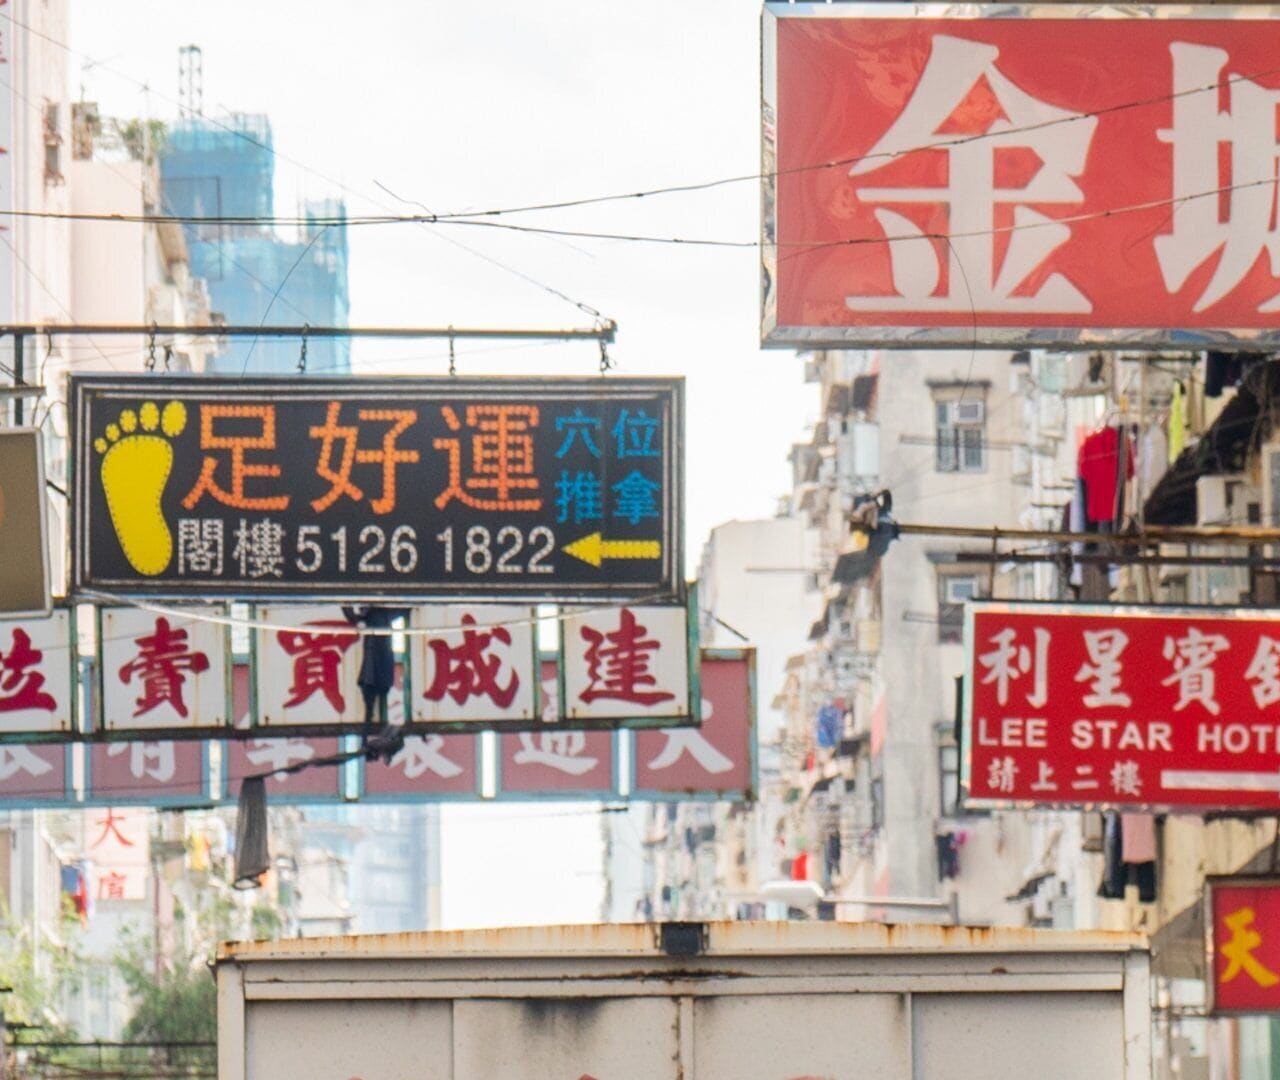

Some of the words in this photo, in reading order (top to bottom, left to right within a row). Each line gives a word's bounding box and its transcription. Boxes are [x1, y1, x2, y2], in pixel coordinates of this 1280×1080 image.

[180, 401, 542, 514] 足好運
[554, 408, 662, 460] 穴位
[554, 470, 662, 525] 推拿
[177, 518, 287, 578] 閣樓
[294, 525, 418, 574] 5126
[435, 525, 556, 574] 1822
[977, 717, 1049, 748] LEE
[1071, 718, 1173, 752] STAR
[986, 755, 1144, 798] 請上二樓
